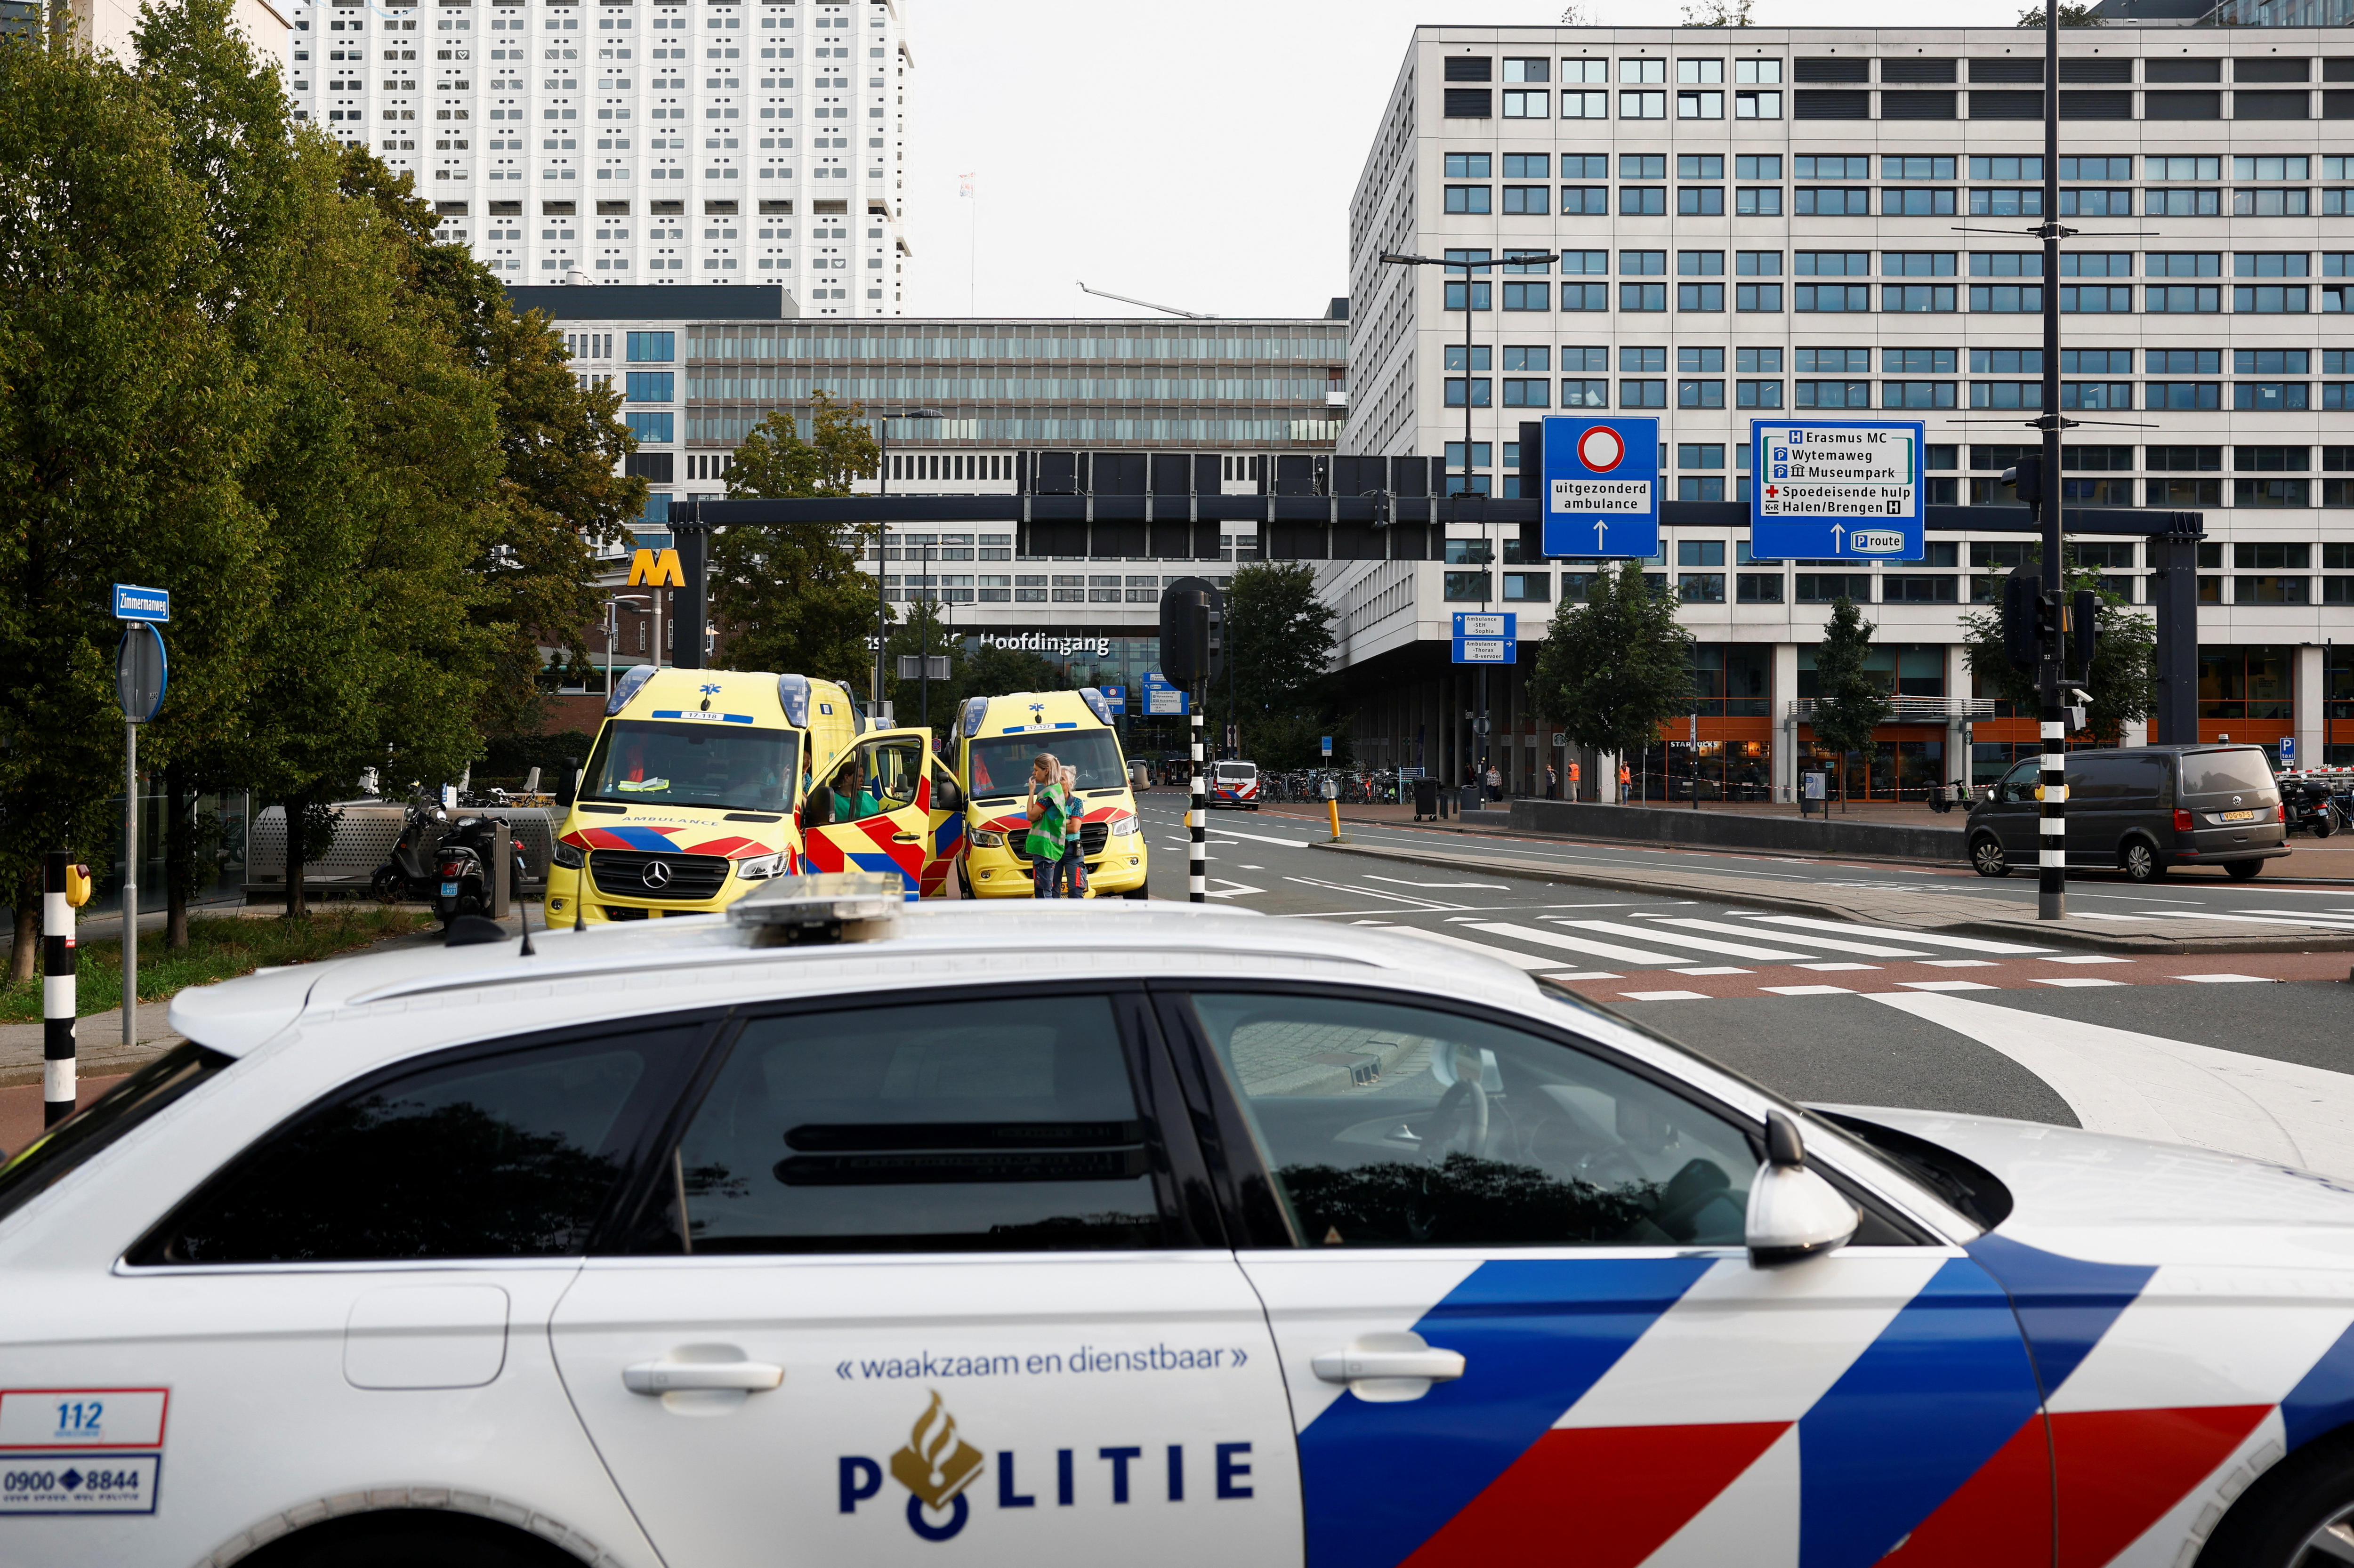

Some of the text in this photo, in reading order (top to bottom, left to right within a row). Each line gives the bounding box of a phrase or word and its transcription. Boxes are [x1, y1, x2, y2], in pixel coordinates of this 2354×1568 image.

[1807, 433, 1862, 443] Erasmus
[1868, 433, 1887, 443] MC
[1792, 450, 1872, 463] Wytemaweg
[1809, 467, 1895, 480] Museumpark
[1556, 482, 1646, 496] uitgezonderd
[1783, 486, 1911, 499] Spoedeisende hulp
[1564, 498, 1637, 509] ambulance
[1783, 502, 1883, 515] Halen/Brengen
[1870, 537, 1900, 546] route
[120, 593, 166, 616] Zimmermanweg
[980, 633, 1109, 656] Hoofdingang
[2283, 739, 2292, 751] P
[621, 817, 719, 827] AMBULANCE
[861, 1350, 1019, 1380] waakzaam
[1026, 1354, 1062, 1374] en
[1069, 1343, 1224, 1373] dienstbaar
[57, 1401, 103, 1429] 112
[4, 1470, 139, 1491] 0900 8844
[838, 1441, 1254, 1542] POLITIE
